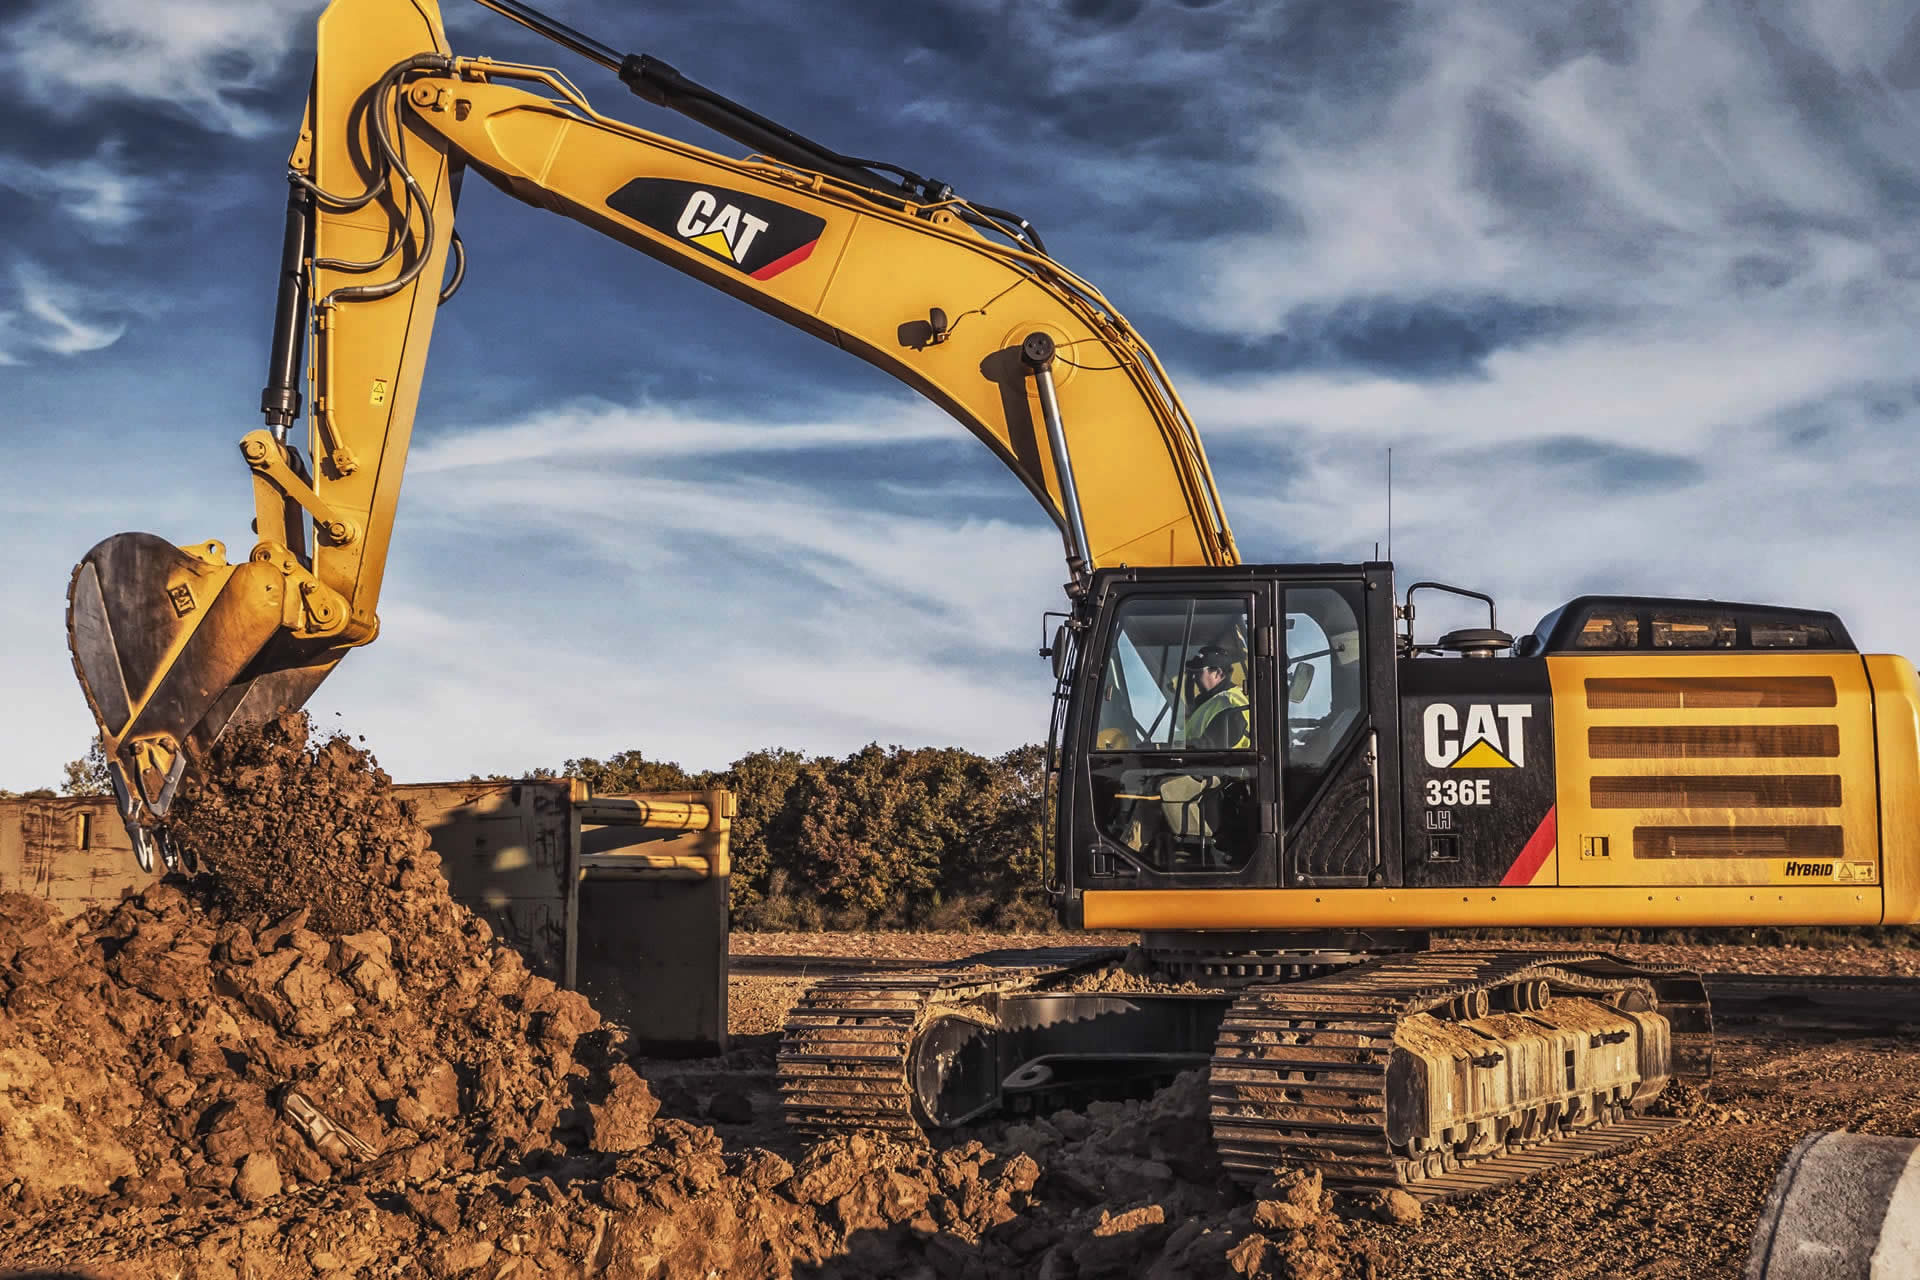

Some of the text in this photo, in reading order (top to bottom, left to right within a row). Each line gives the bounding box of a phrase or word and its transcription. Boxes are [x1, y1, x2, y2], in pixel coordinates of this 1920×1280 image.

[677, 190, 769, 264] CAT
[170, 585, 195, 613] CAT
[1423, 703, 1532, 768] CAT
[1426, 780, 1491, 805] 336E
[1426, 811, 1451, 829] LH
[1785, 861, 1833, 876] HYBRID
